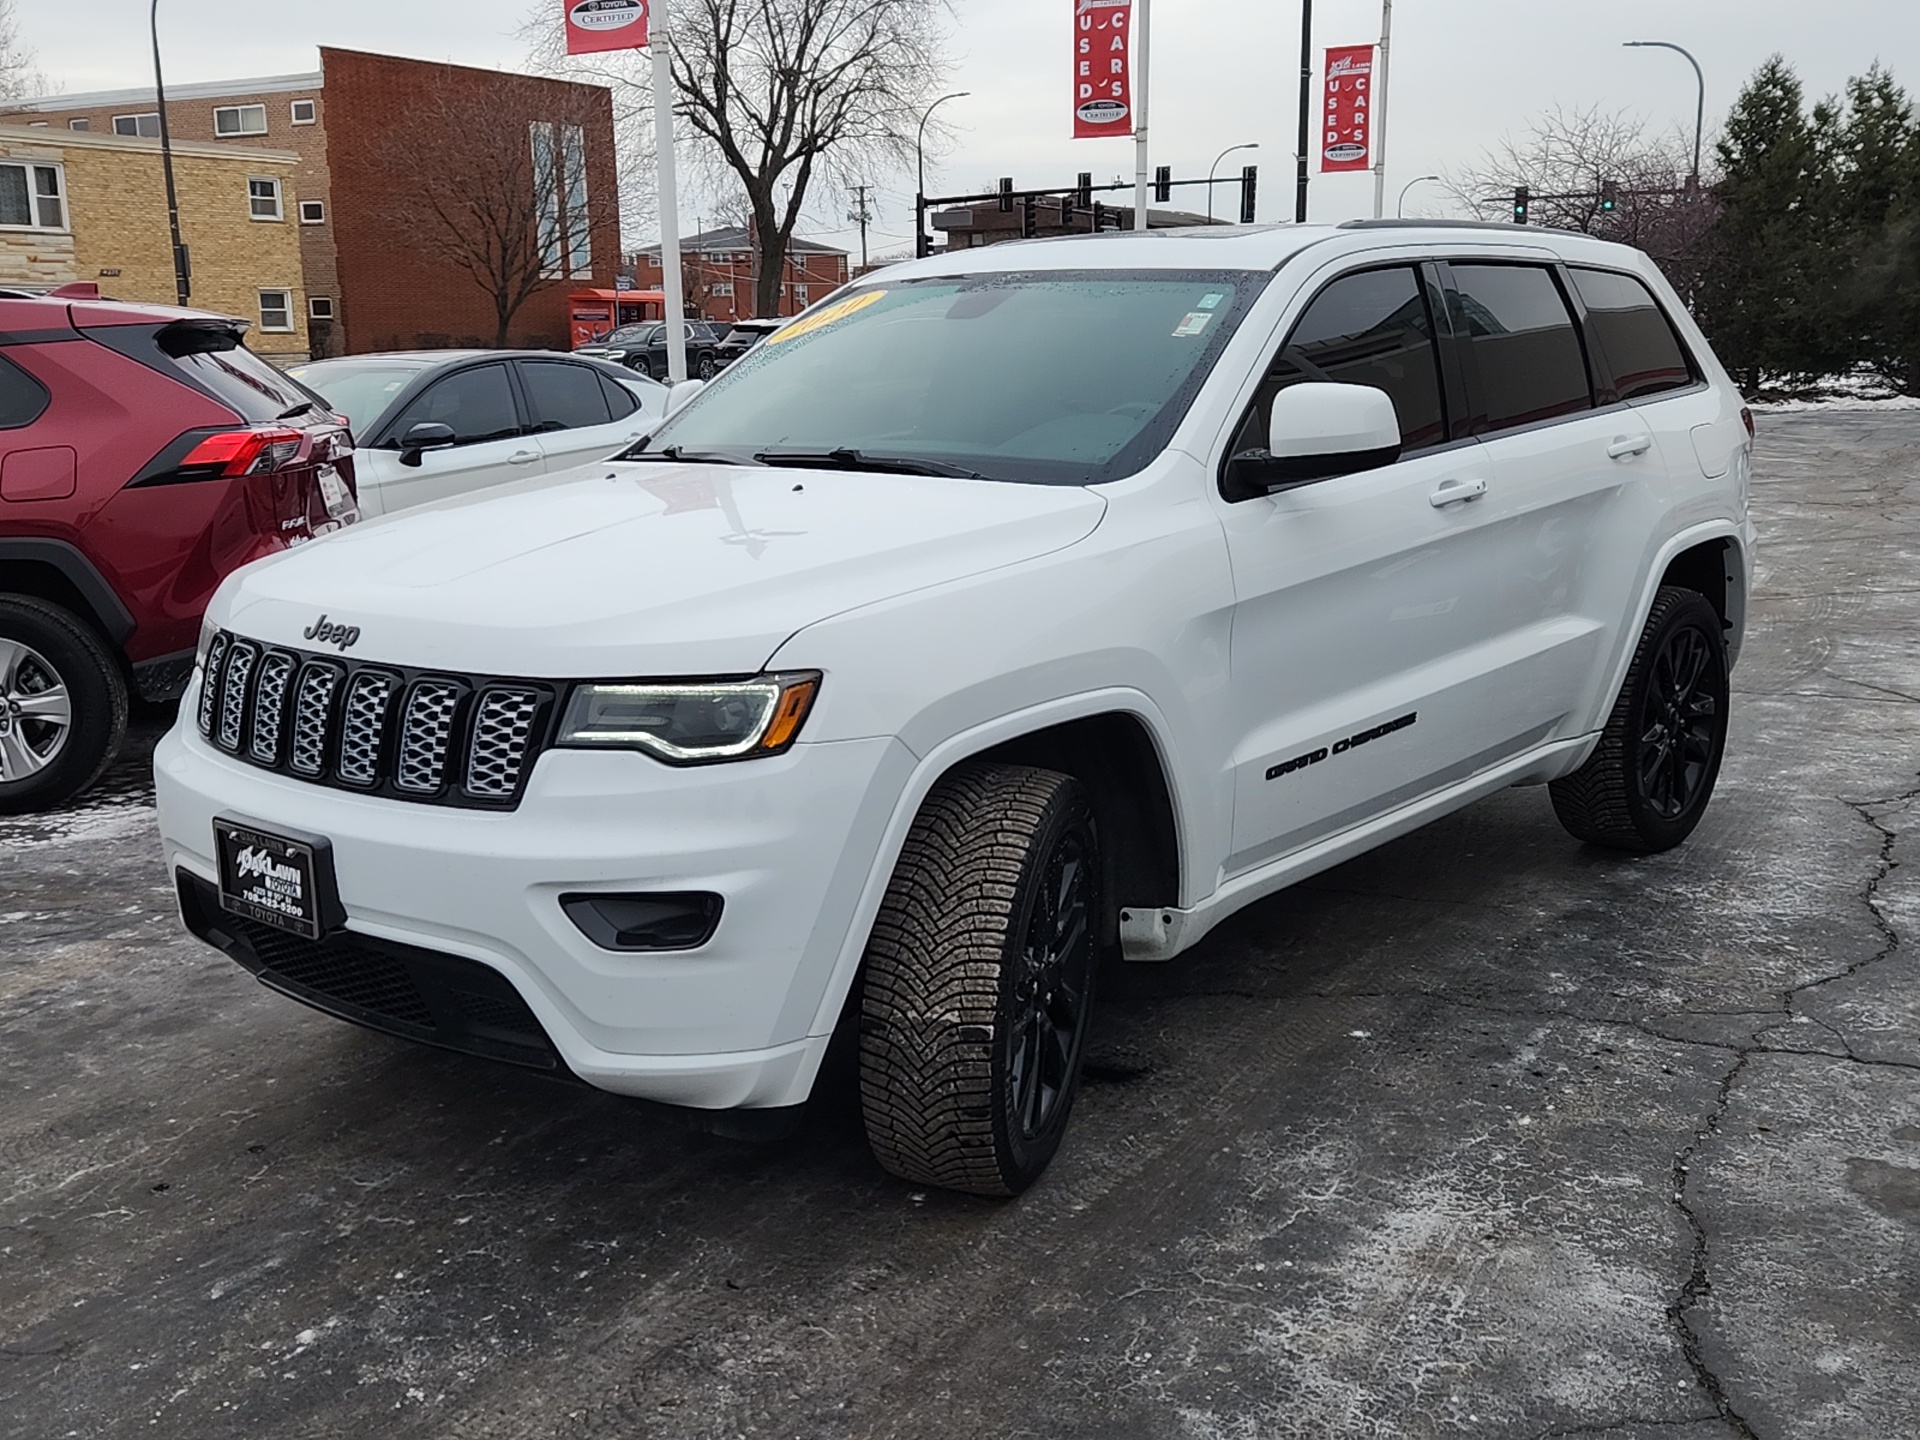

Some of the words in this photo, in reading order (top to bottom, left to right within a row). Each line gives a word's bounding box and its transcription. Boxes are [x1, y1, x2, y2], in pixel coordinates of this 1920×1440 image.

[581, 12, 634, 24] CERTIFIED
[600, 0, 628, 9] TOYOTA
[1079, 15, 1092, 99] USED
[1110, 12, 1125, 97] CARS
[1327, 80, 1339, 143] USED
[1354, 78, 1366, 141] CARS
[303, 614, 360, 652] Jeep
[1265, 747, 1329, 781] GRAND
[1332, 711, 1417, 755] CHEROKEE
[249, 906, 284, 926] TOYOTA
